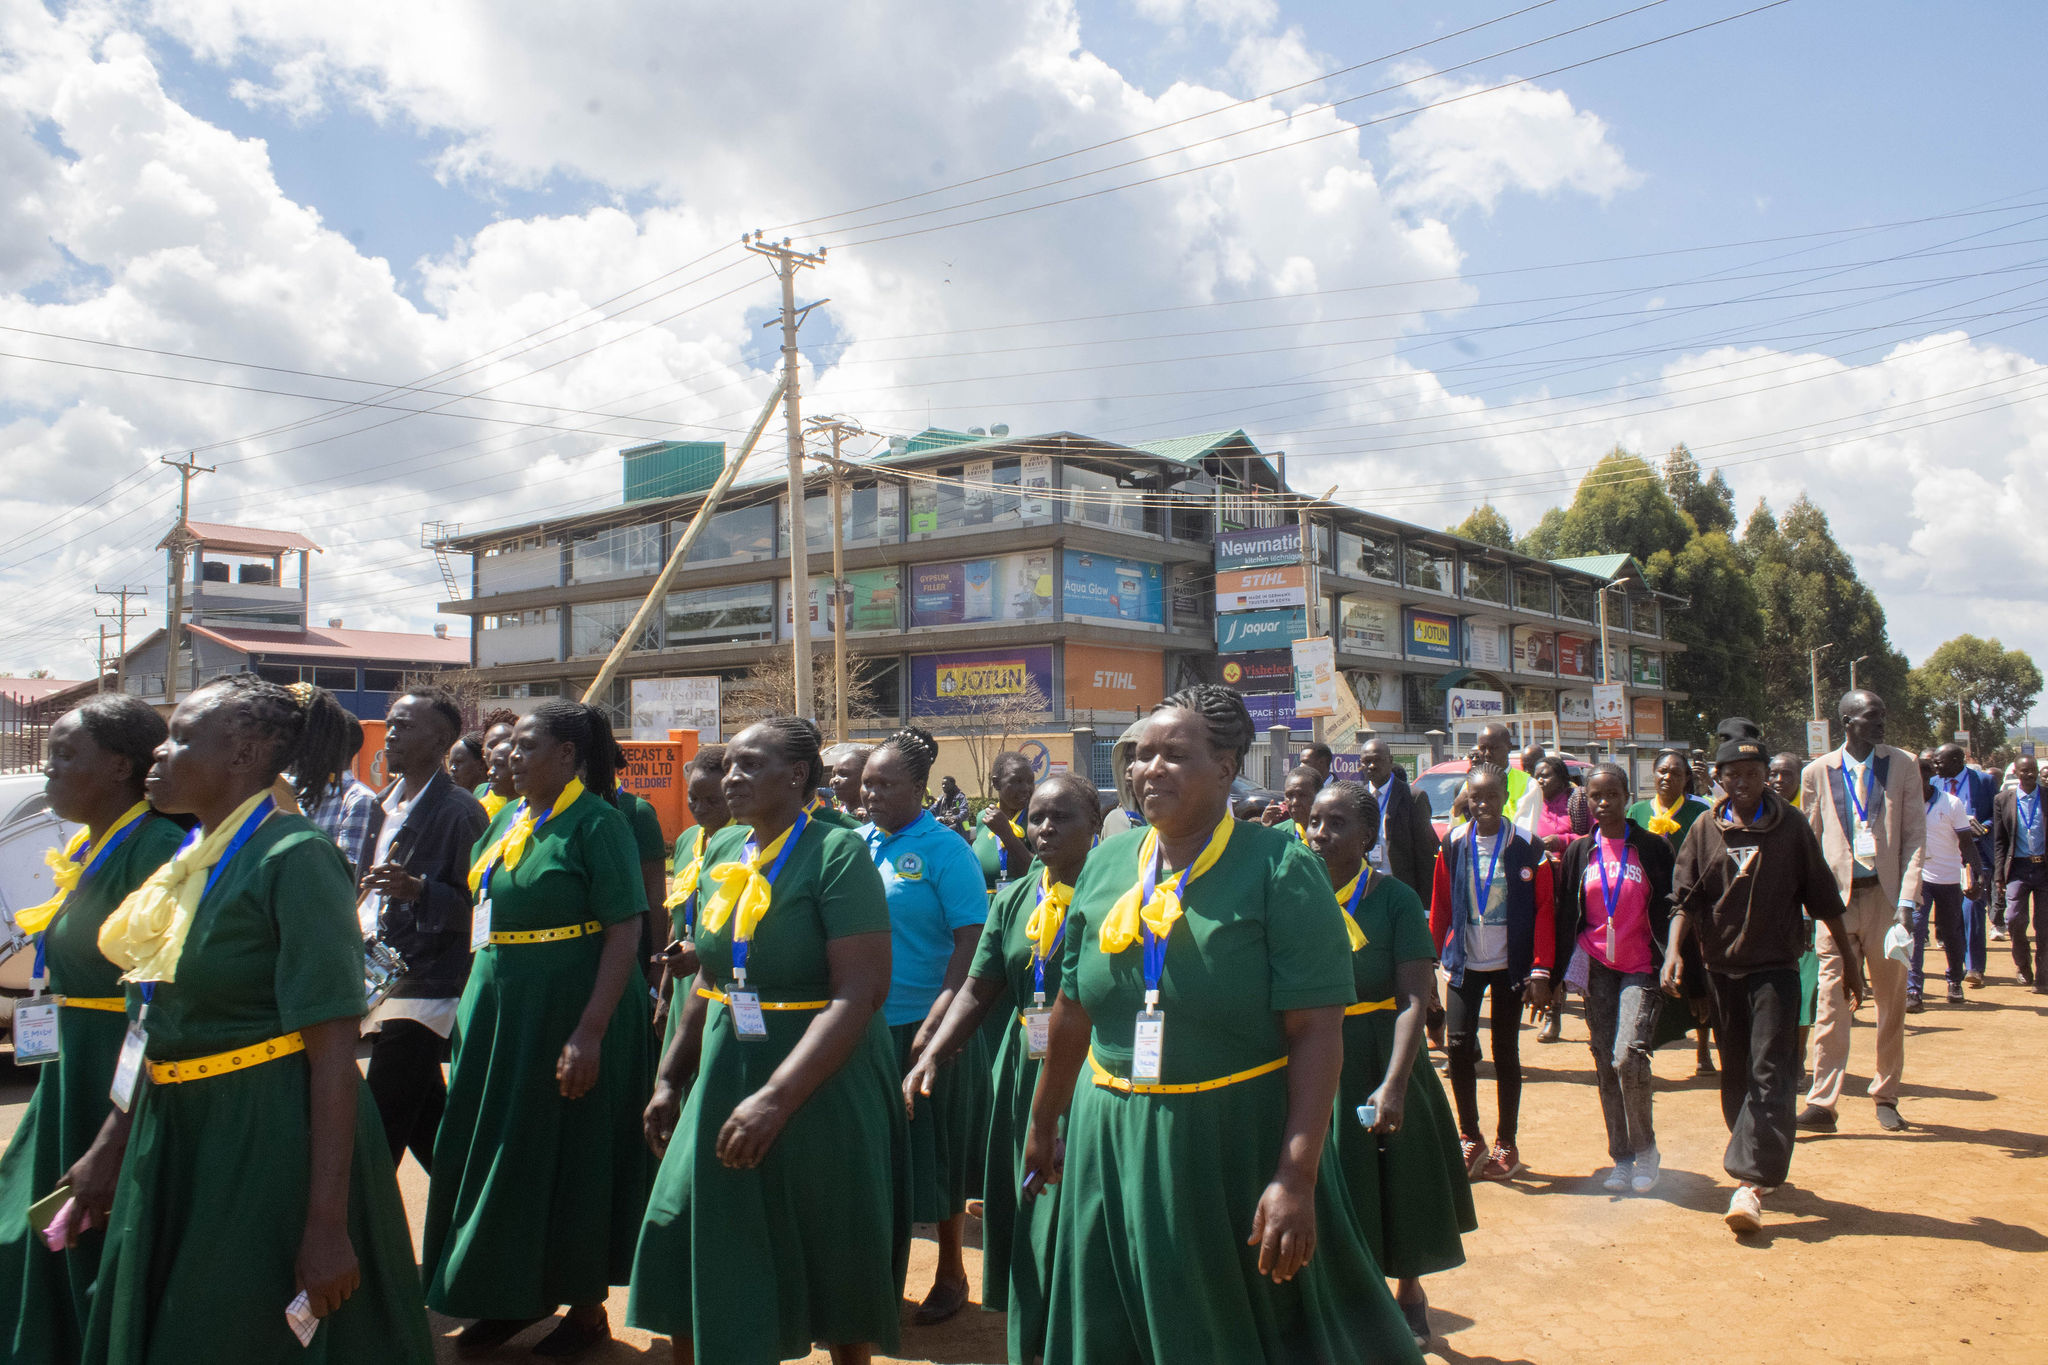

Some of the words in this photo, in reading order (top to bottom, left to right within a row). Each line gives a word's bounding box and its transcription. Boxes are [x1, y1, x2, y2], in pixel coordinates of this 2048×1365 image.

[920, 574, 949, 583] GYPSUM
[1241, 573, 1287, 588] STIHL
[923, 583, 946, 592] FILLER
[1064, 579, 1087, 595] Aqua
[1088, 582, 1110, 596] Glow
[1423, 624, 1448, 641] JOTUN
[960, 668, 1022, 691] JOTUN
[1093, 670, 1137, 690] STIHL
[666, 748, 675, 761] &
[652, 762, 672, 775] LTD
